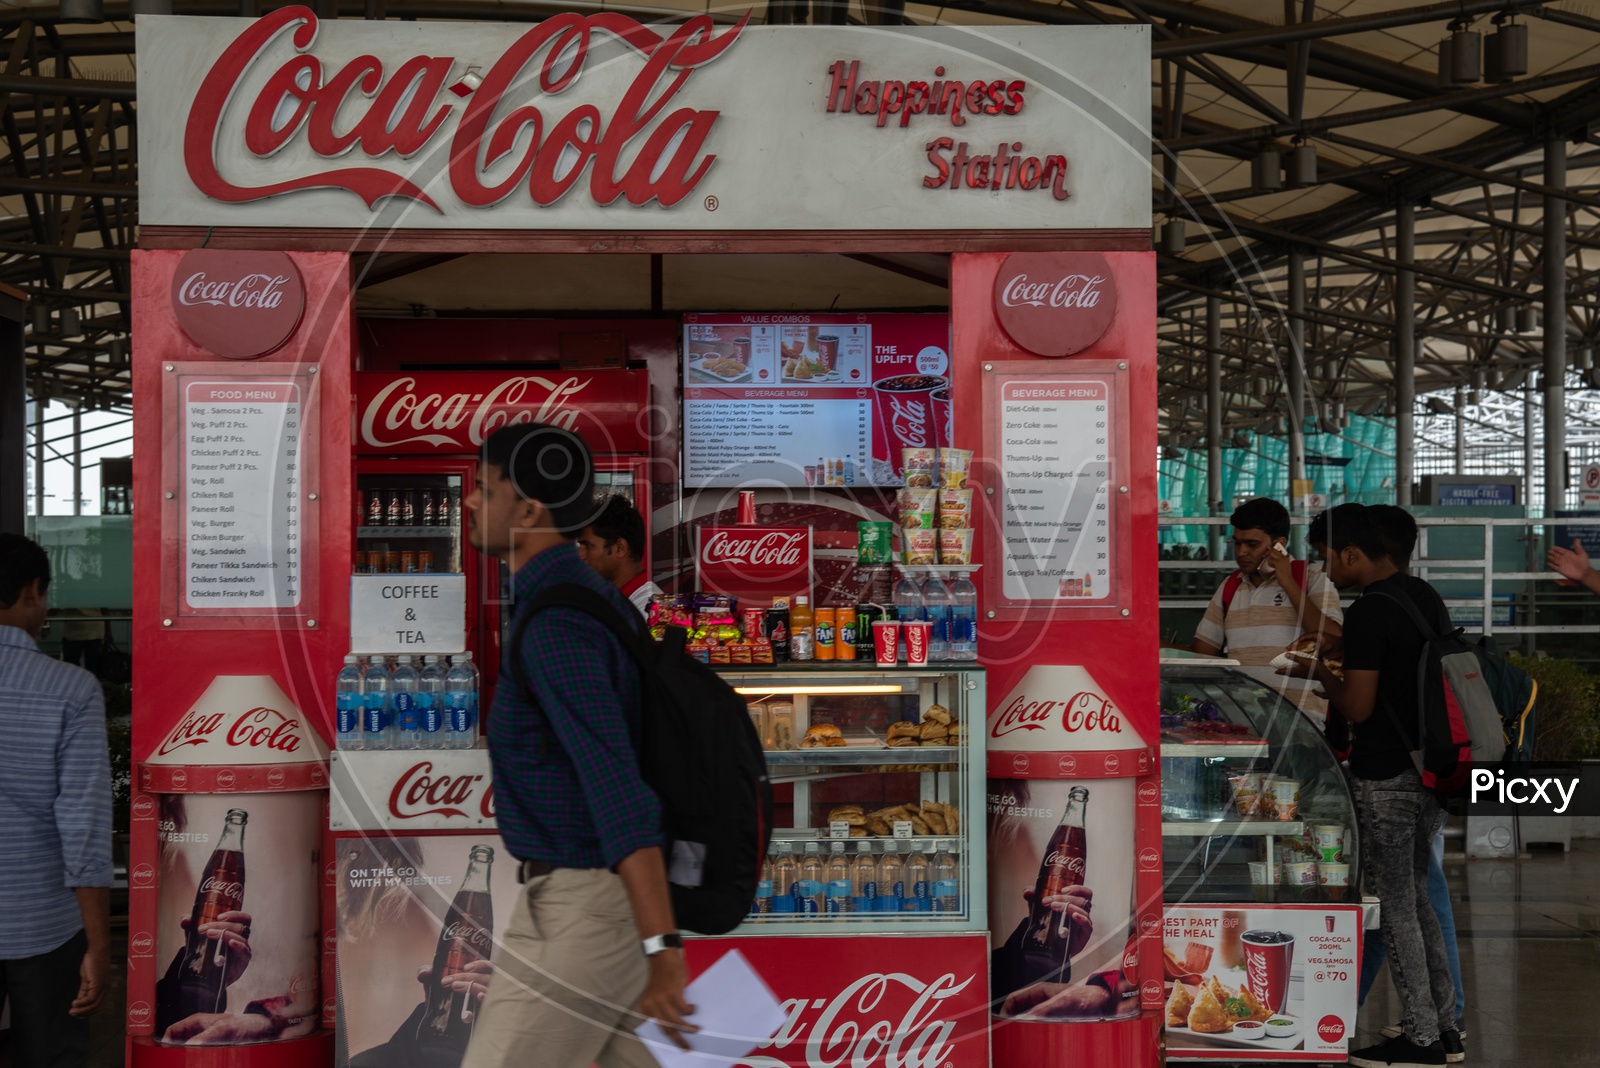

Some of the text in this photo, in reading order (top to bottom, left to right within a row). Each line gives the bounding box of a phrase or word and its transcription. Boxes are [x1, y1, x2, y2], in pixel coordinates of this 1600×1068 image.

[826, 60, 1026, 128] Happiness
[183, 4, 752, 214] Coca-Cola
[922, 136, 1072, 201] Station
[178, 272, 291, 309] Coca-Cola
[1002, 274, 1107, 308] Coca-Cola
[741, 315, 810, 323] VALUE COMBOS
[875, 346, 897, 354] THE
[875, 355, 913, 364] UPLIFT
[210, 391, 276, 399] FOOD MENU
[1012, 389, 1098, 397] BEVERAGE MENU
[361, 376, 593, 447] Coca-Cola
[191, 421, 207, 430] Veg.
[191, 436, 205, 444] Egg
[191, 463, 218, 471] Paneer
[1044, 471, 1073, 479] Charged
[191, 478, 207, 486] Veg.
[1452, 489, 1500, 499] HASSLE-FREE
[191, 520, 208, 528] Veg.
[210, 520, 235, 528] Burger
[219, 534, 244, 542] Burger
[191, 548, 208, 556] Veg.
[702, 531, 807, 566] Coca-Cola
[241, 561, 278, 569] Sandwich
[1007, 569, 1034, 577] Georgia
[223, 590, 248, 598] Franky
[381, 585, 439, 600] COFFEE
[404, 607, 417, 621] &
[396, 630, 425, 644] TEA
[340, 710, 348, 732] smart
[458, 709, 466, 731] smart
[1001, 796, 1016, 805] GO
[993, 808, 1053, 818] MY BESTIES
[163, 822, 175, 831] GO
[167, 833, 209, 843] BESTIES
[350, 866, 415, 879] ON THE GO
[350, 875, 452, 888] WITH MY BESTIES
[1189, 918, 1219, 928] PART
[1222, 918, 1239, 929] OF
[1162, 928, 1215, 938] HE MEAL
[1308, 935, 1352, 943] COCA-COLA
[1307, 957, 1354, 965] VEG.SAMOSA
[1313, 970, 1325, 983] @
[1318, 1023, 1343, 1034] Coca-Cola
